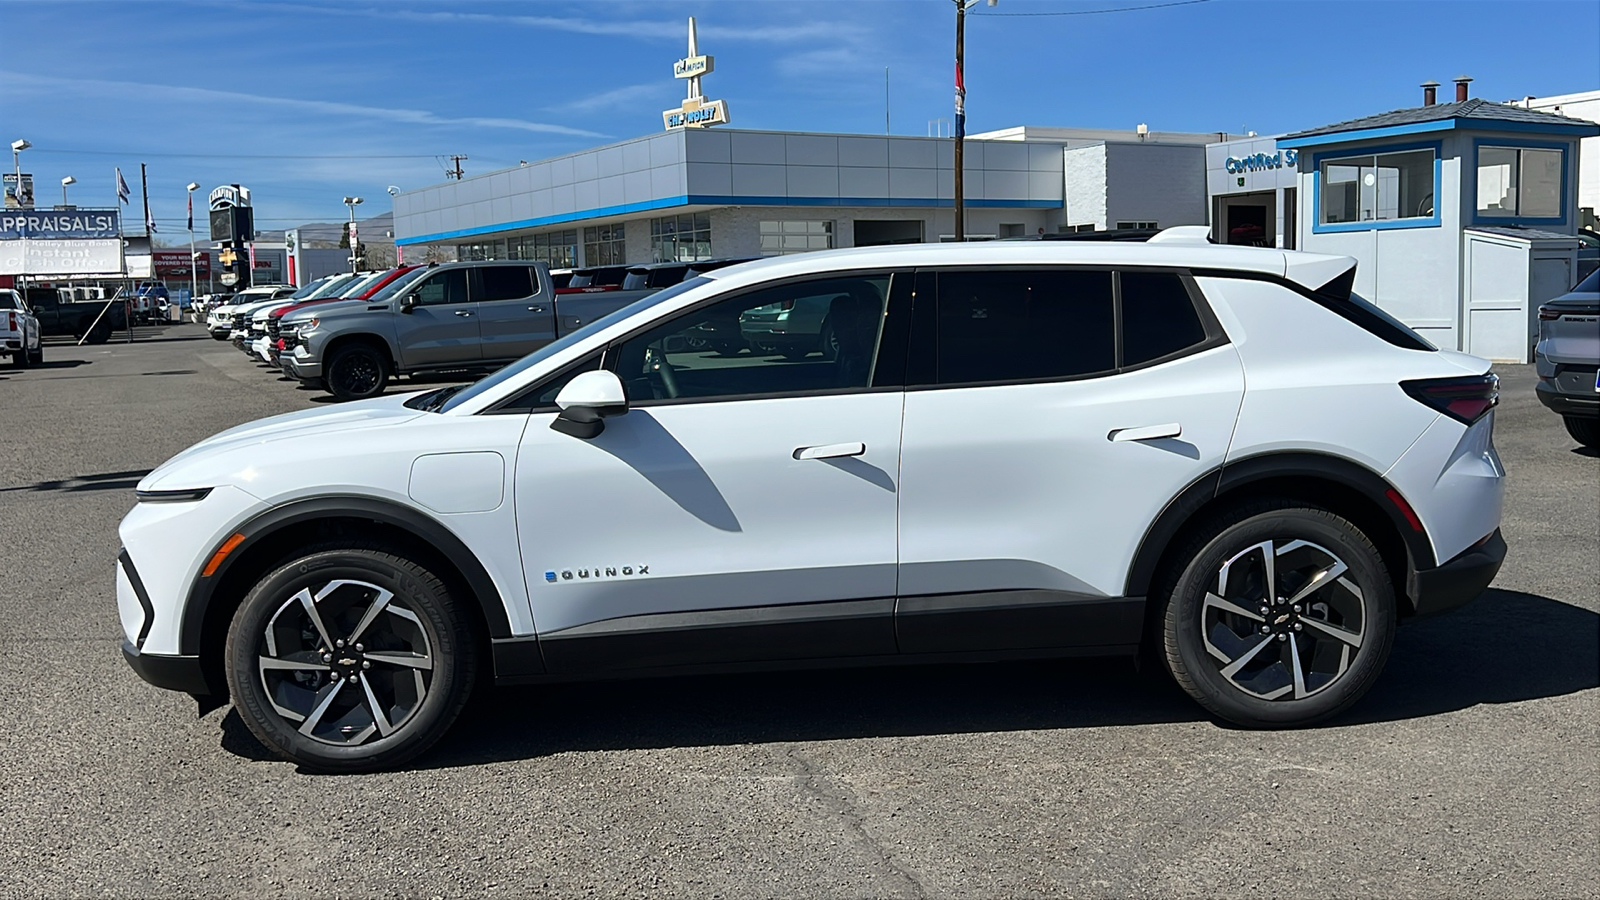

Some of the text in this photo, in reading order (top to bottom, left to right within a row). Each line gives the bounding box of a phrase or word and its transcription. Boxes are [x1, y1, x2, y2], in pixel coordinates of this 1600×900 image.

[1226, 151, 1281, 171] Certified
[0, 216, 113, 232] PPRAISALS!
[25, 247, 91, 258] Instant
[545, 564, 650, 583] EQUINOX
